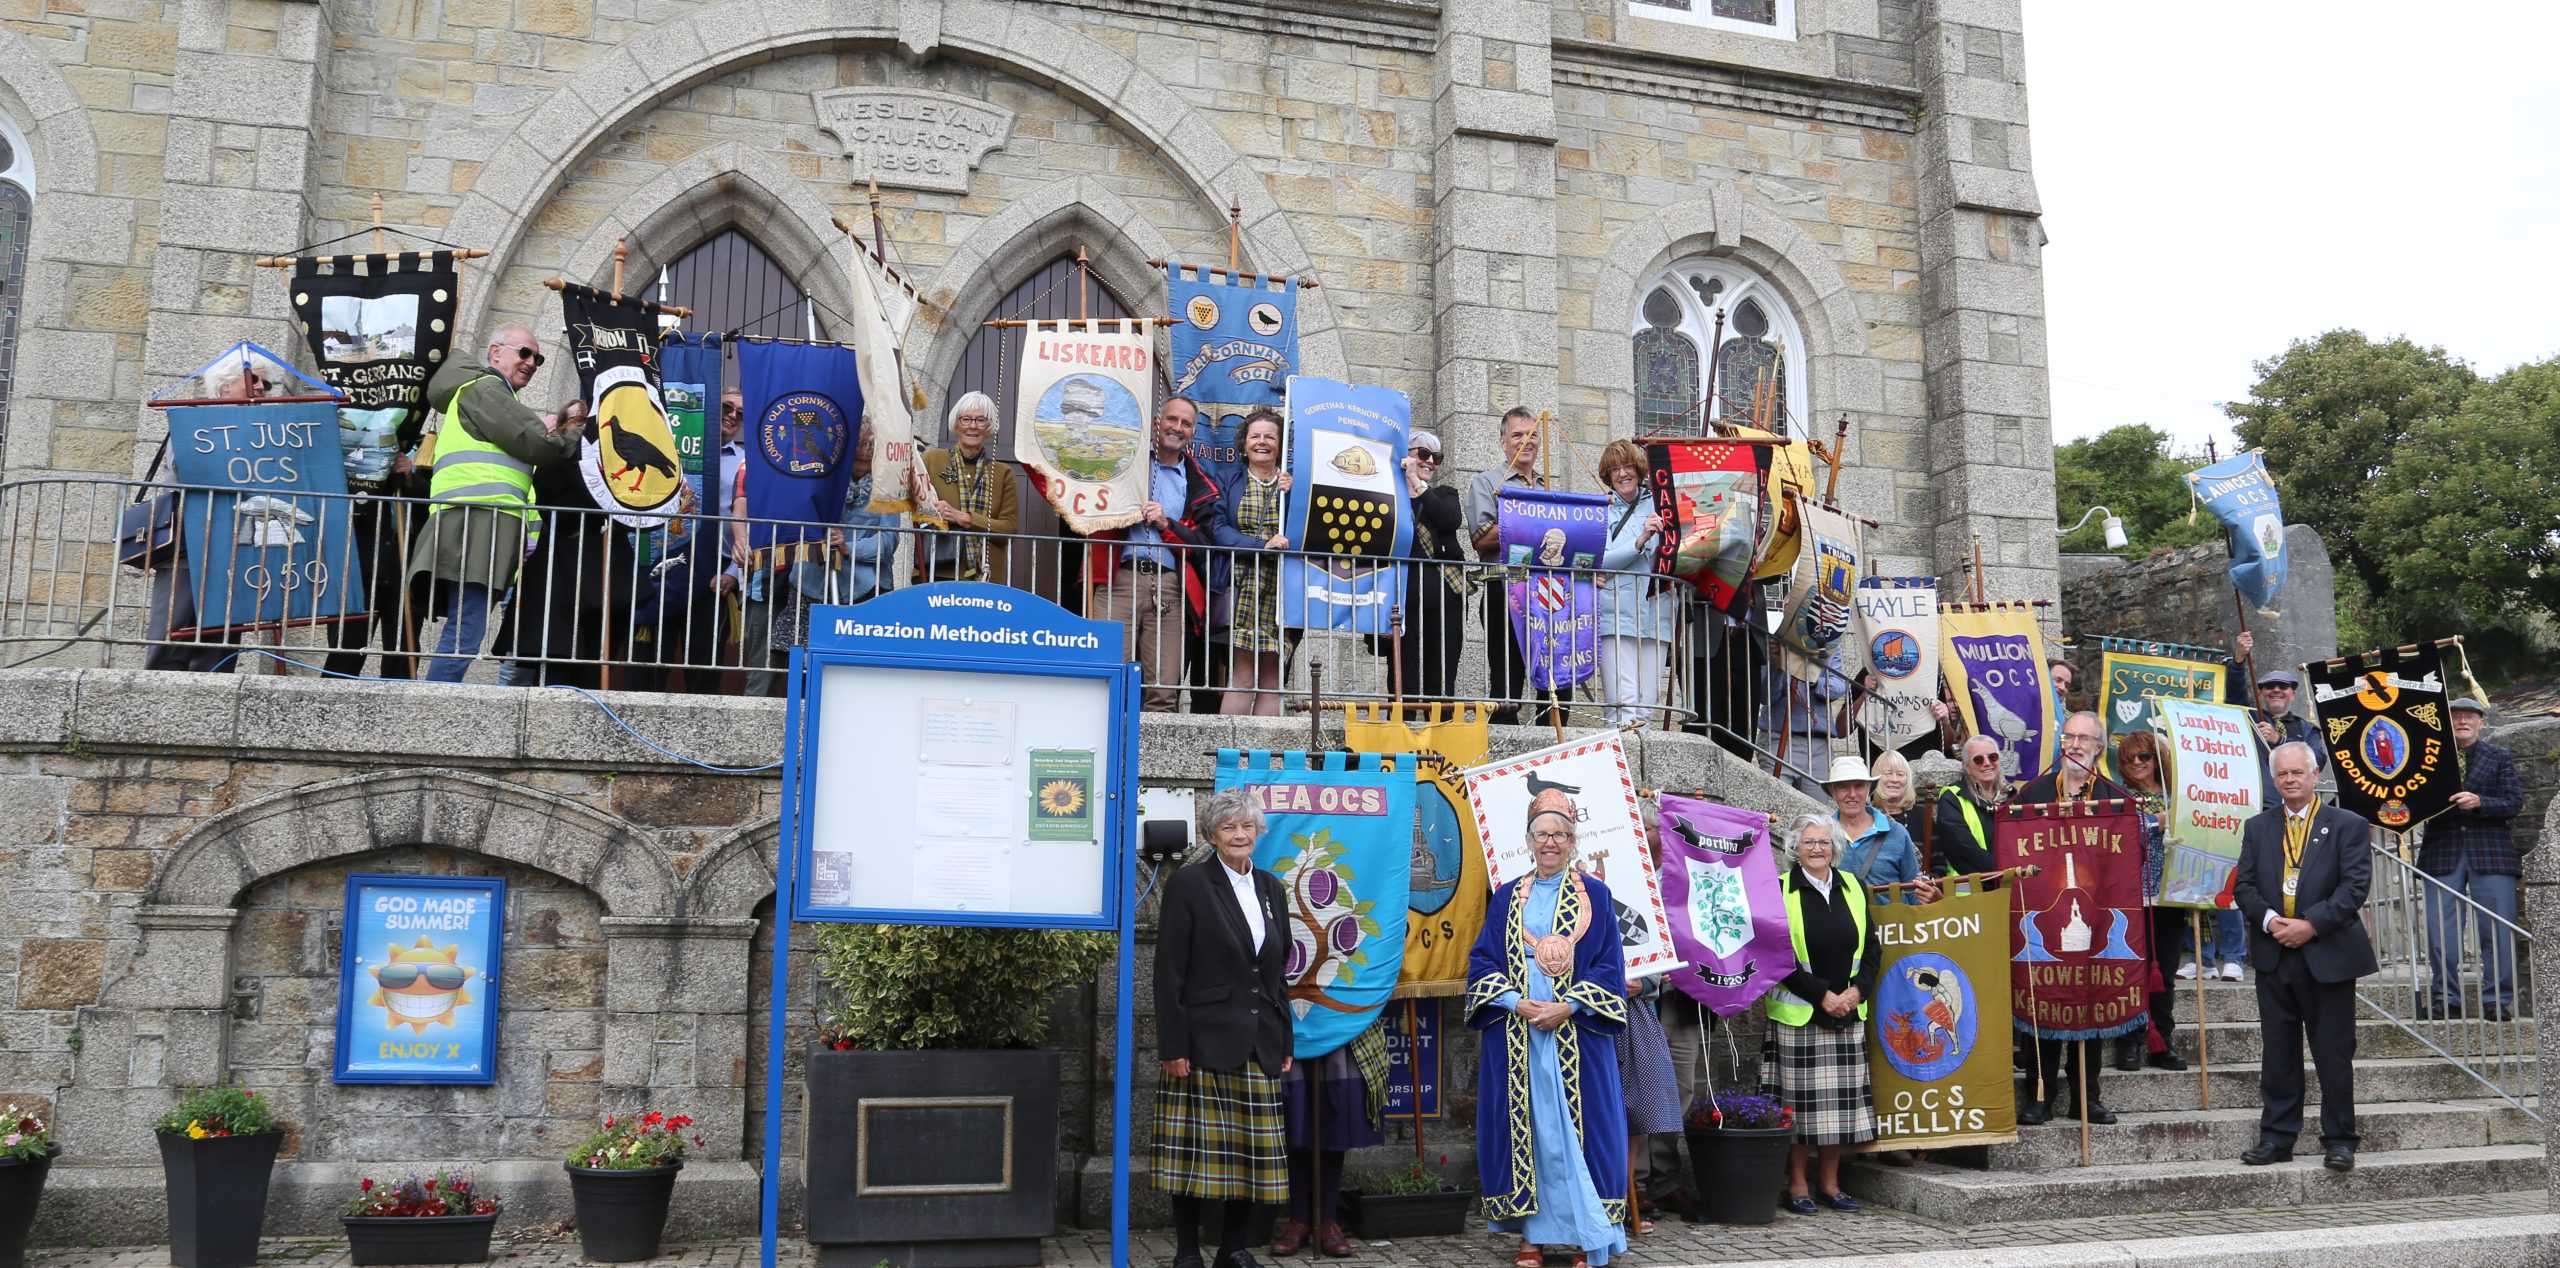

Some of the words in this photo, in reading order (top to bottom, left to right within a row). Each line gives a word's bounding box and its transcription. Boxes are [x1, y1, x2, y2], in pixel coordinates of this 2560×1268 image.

[829, 101, 998, 136] WESLEYAN
[852, 126, 970, 151] CHURCH
[1039, 341, 1147, 371] LISKEARD
[1190, 353, 1208, 376] OLD
[1210, 342, 1282, 366] CORNWAL
[353, 364, 426, 385] GERRANS
[1231, 368, 1275, 382] SOCI
[769, 403, 786, 421] OLD
[788, 396, 838, 421] CORNWALL
[1304, 402, 1345, 416] GOWETHAS
[1347, 403, 1380, 419] KERNOW
[1382, 415, 1400, 432] GOTH
[250, 422, 321, 449] JUST
[764, 424, 783, 462] LONDON
[2196, 469, 2265, 505] LAUNCEST
[1518, 501, 1567, 521] GORAN
[1573, 506, 1605, 522] OCS
[1656, 469, 1678, 575] CARNON
[1826, 546, 1851, 563] TRURO
[927, 593, 994, 610] Welcome
[997, 597, 1012, 612] to
[1855, 595, 1928, 618] HAYLE
[834, 618, 925, 640] Marazion
[930, 624, 1028, 645] Methodist
[1031, 629, 1099, 649] Church
[1957, 642, 2033, 661] MULLION
[1985, 668, 2036, 688] OCS
[2142, 672, 2211, 690] COLUMB
[2181, 735, 2193, 751] &
[2196, 735, 2248, 758] District
[2203, 762, 2229, 780] Old
[2335, 749, 2389, 799] BODMIN
[2394, 772, 2427, 799] OCS
[2421, 737, 2441, 772] 1927
[1250, 785, 1312, 811] KEA
[1319, 787, 1380, 812] OCS
[2187, 783, 2250, 806] Cornwall
[2017, 825, 2123, 857] KELLIWIK
[375, 896, 417, 913] GOD
[422, 897, 476, 914] MADE
[385, 914, 469, 931] SUMMER!
[1875, 913, 1980, 946] HELSTON
[2032, 965, 2125, 987] KOWEHAS
[2093, 986, 2141, 1023] GOTH
[379, 1041, 440, 1058] ENJOY
[446, 1043, 460, 1058] X
[1877, 1108, 1986, 1136] HELLYS
